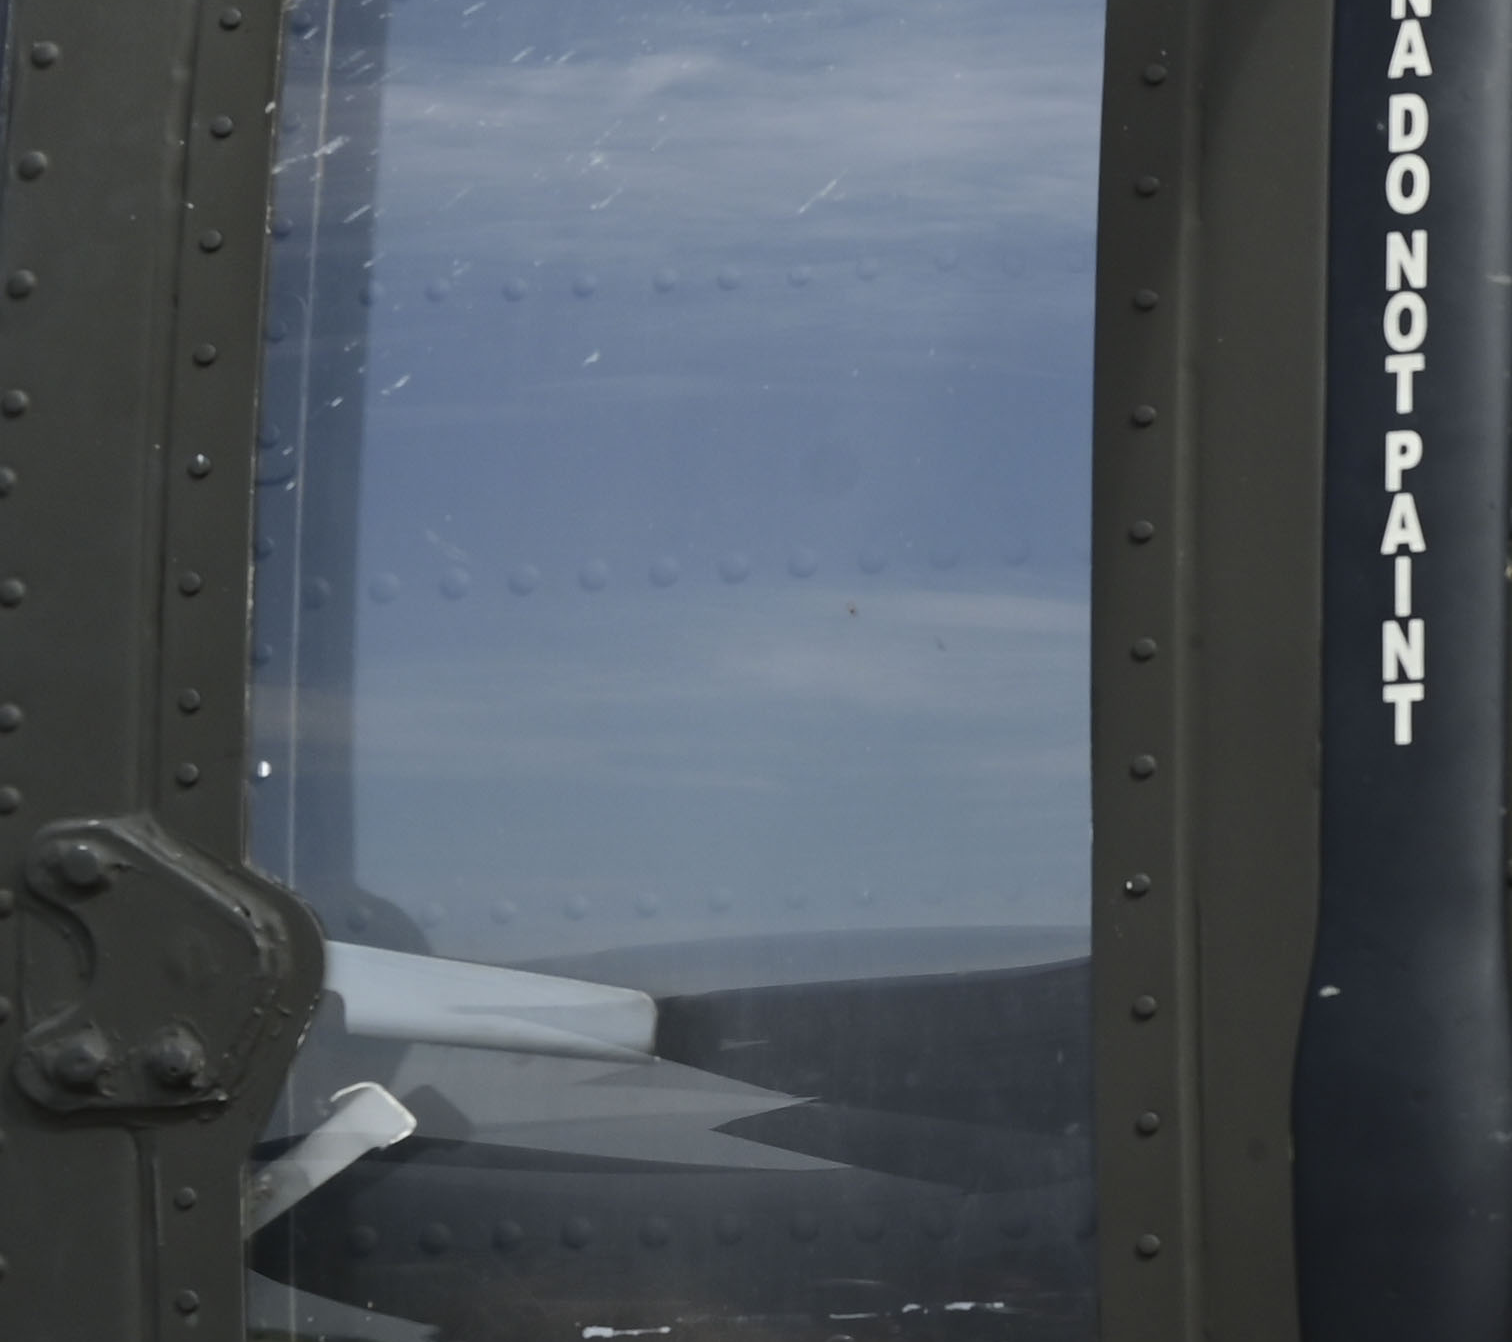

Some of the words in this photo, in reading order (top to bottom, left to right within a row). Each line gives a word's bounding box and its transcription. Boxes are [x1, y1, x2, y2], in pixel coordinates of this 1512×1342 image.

[1385, 92, 1430, 215] DO
[1383, 229, 1428, 415] NOT
[1380, 430, 1427, 745] PAINT
